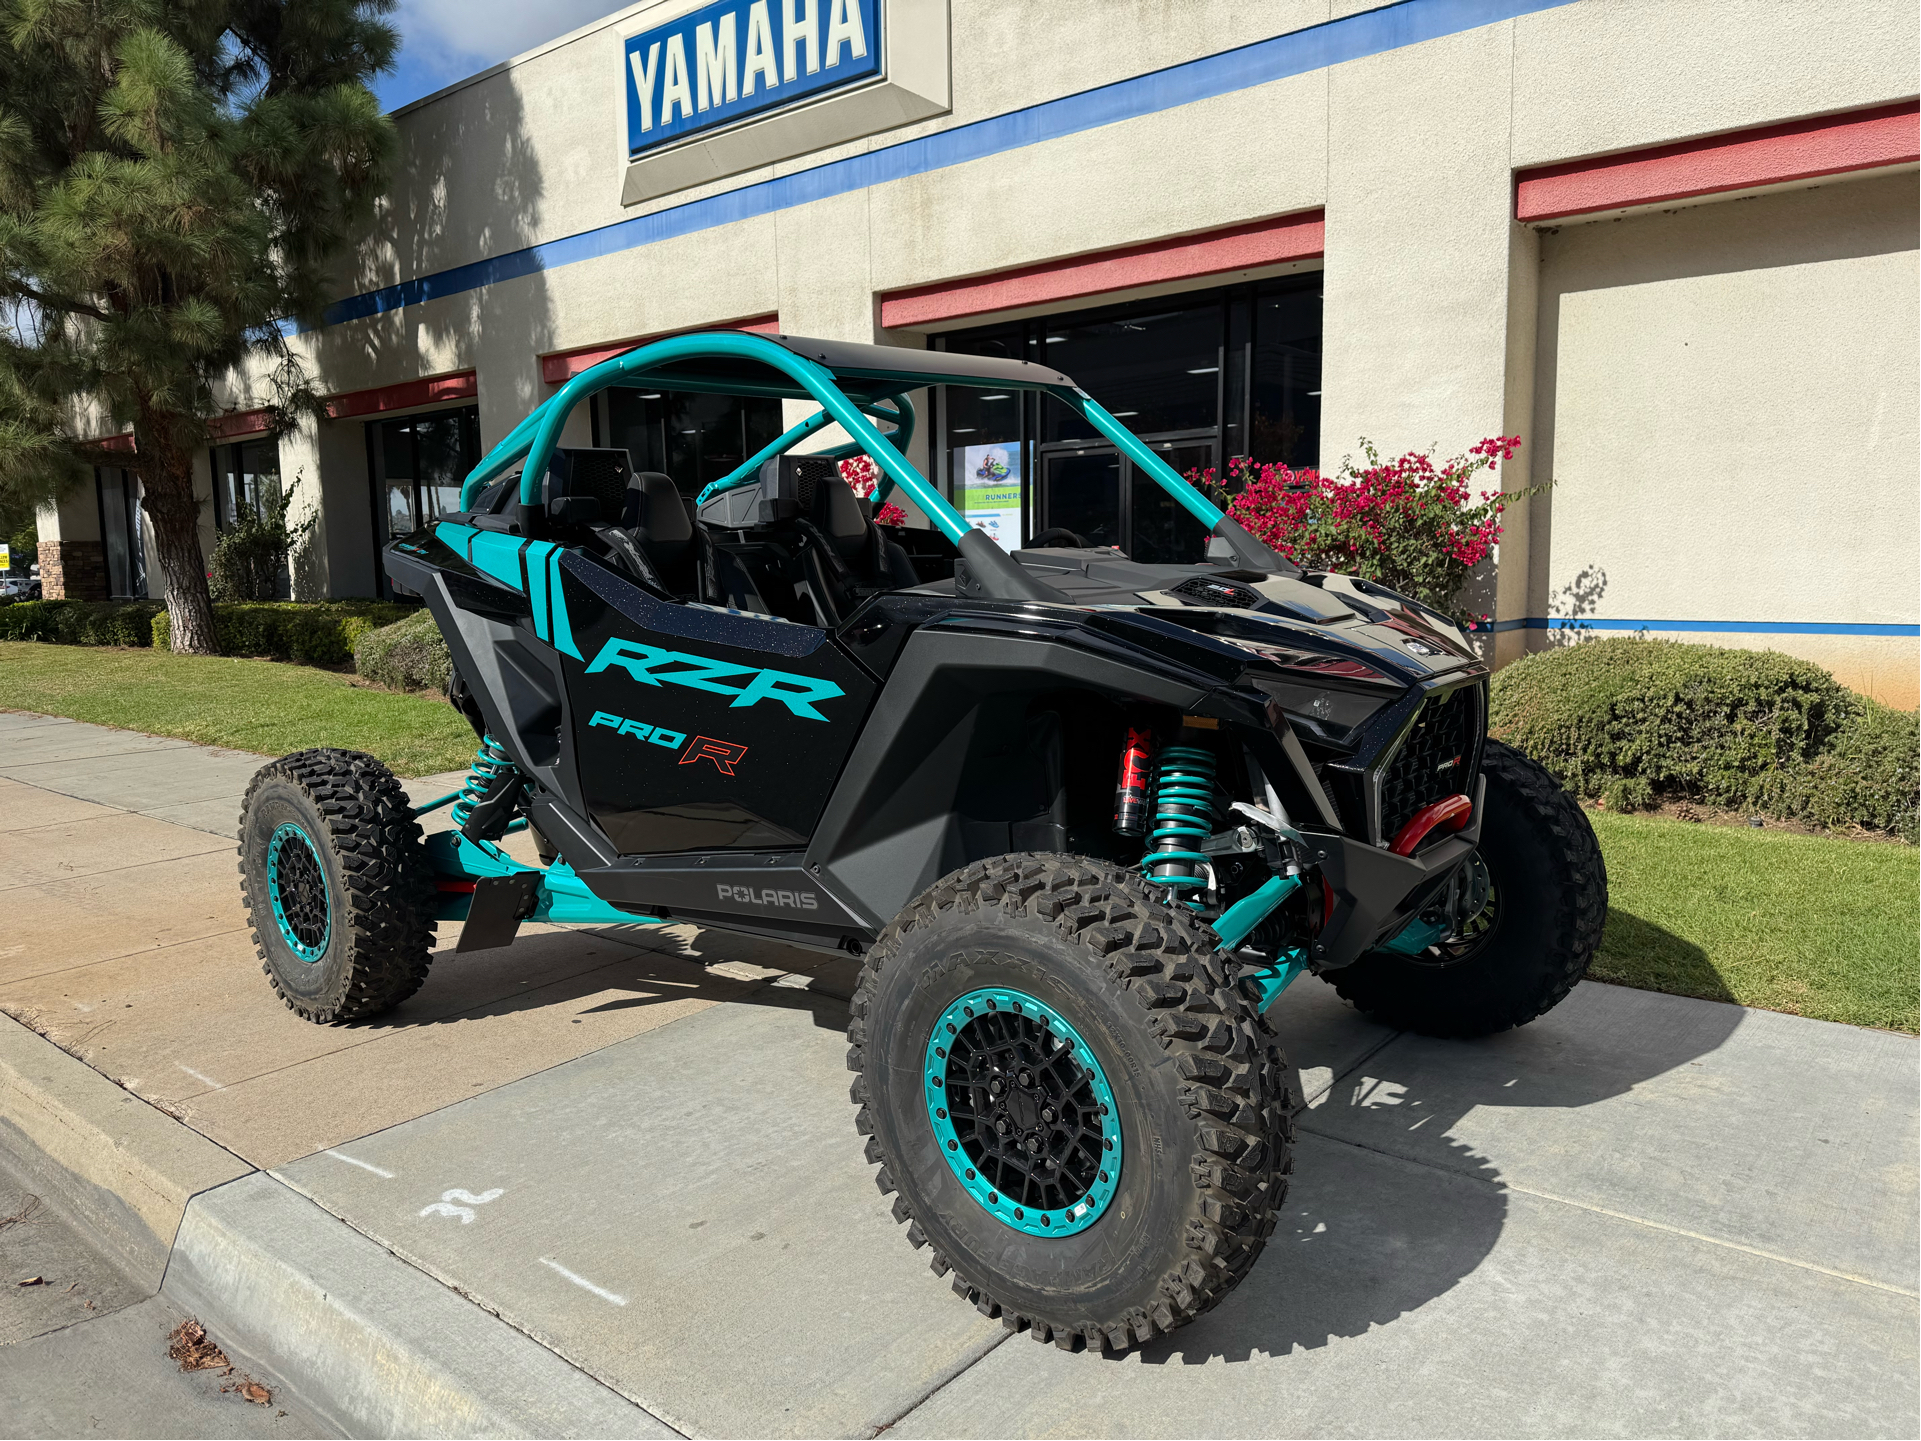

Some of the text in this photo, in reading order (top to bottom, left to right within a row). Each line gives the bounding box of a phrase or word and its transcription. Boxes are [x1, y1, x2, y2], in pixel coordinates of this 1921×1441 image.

[629, 0, 867, 133] YAMAHA
[584, 637, 846, 722] RZR
[588, 711, 749, 776] PRO R
[1121, 727, 1151, 790] FOX
[1436, 757, 1461, 772] PRO R
[716, 884, 818, 910] POLARIS
[921, 949, 1071, 1000] MAXXIS
[1153, 1136, 1163, 1154] NHS
